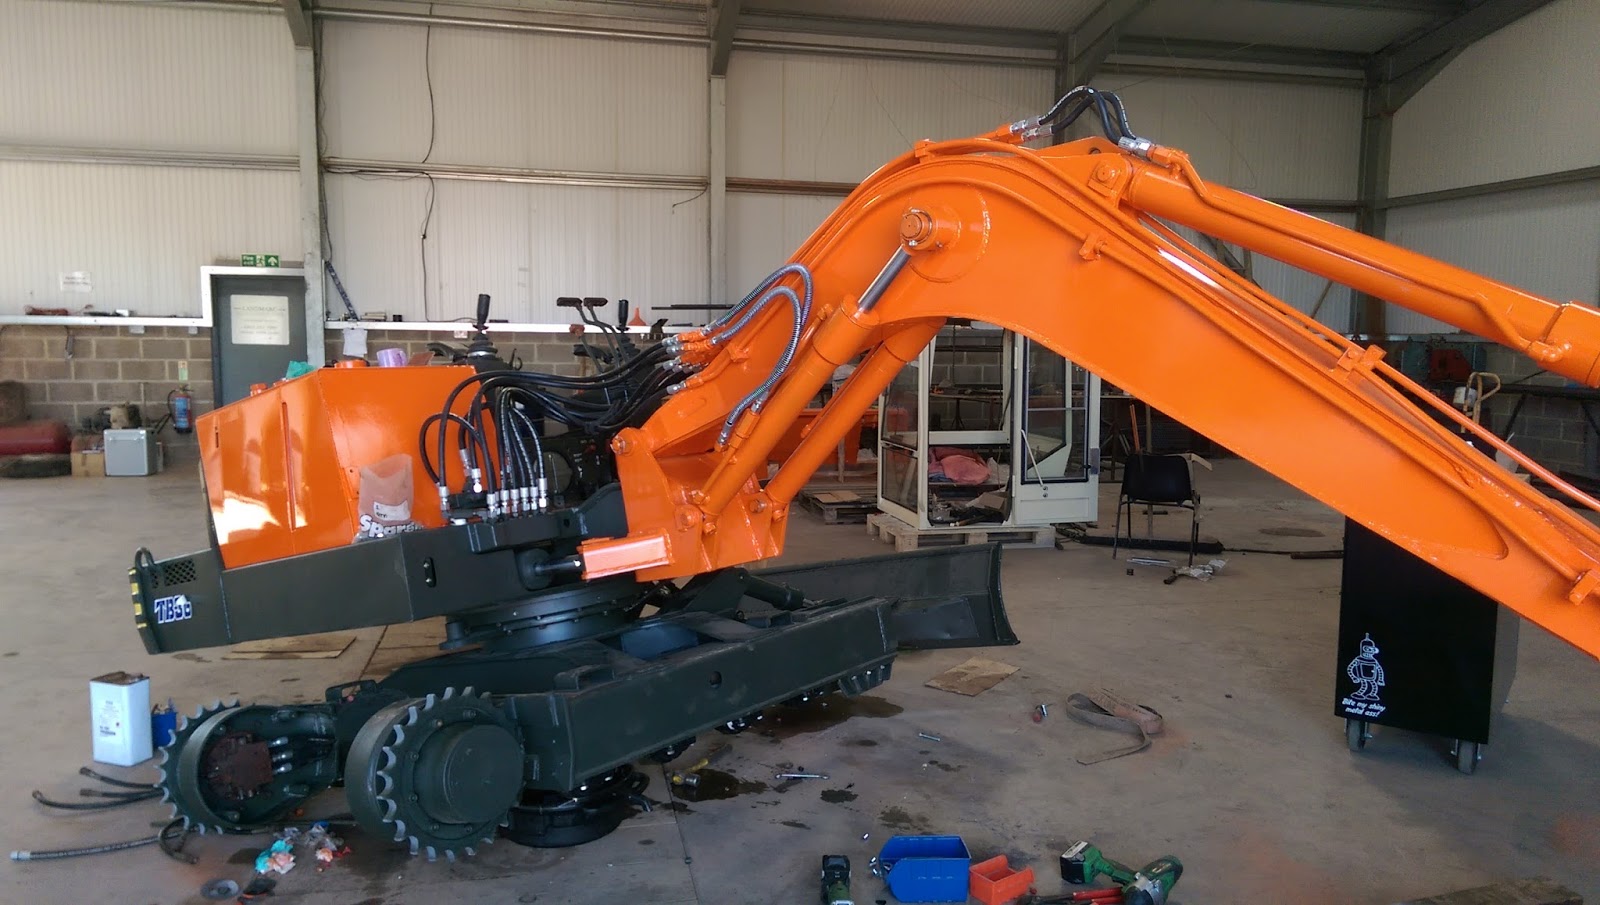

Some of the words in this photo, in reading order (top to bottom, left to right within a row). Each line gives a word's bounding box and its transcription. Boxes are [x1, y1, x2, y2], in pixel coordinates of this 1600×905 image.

[1342, 698, 1356, 706] Bite
[1368, 703, 1386, 712] shiny
[1345, 707, 1365, 715] metal
